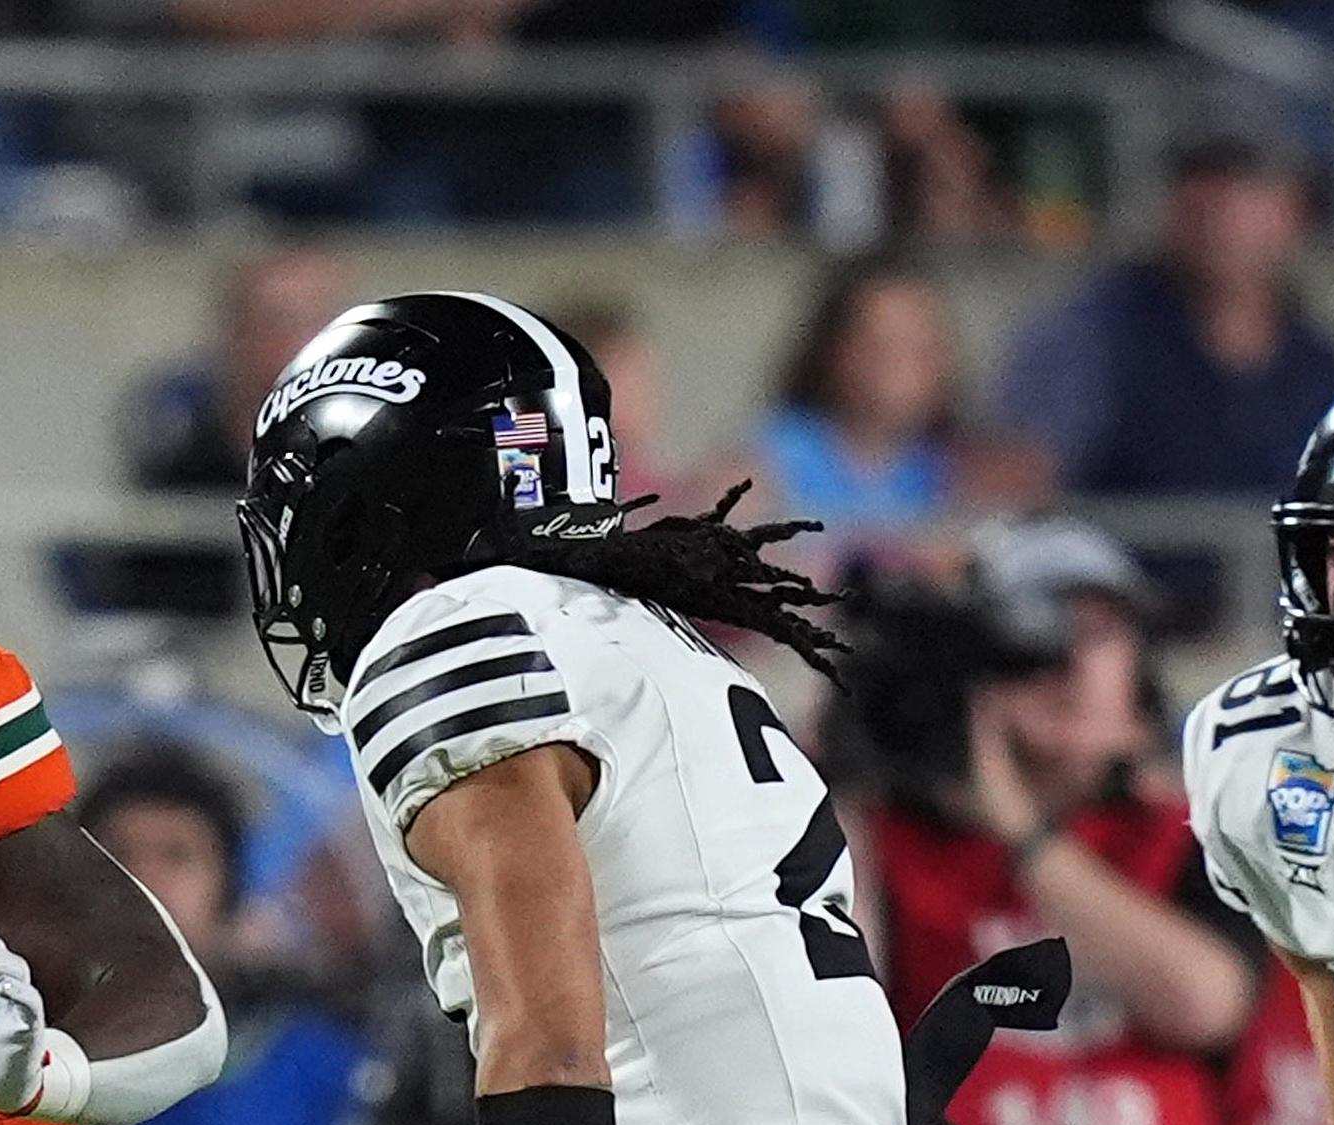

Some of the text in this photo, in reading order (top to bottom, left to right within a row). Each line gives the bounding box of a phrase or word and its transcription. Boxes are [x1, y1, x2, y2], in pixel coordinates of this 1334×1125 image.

[256, 356, 427, 438] Cyclones
[588, 416, 613, 500] 2
[728, 684, 879, 981] 2
